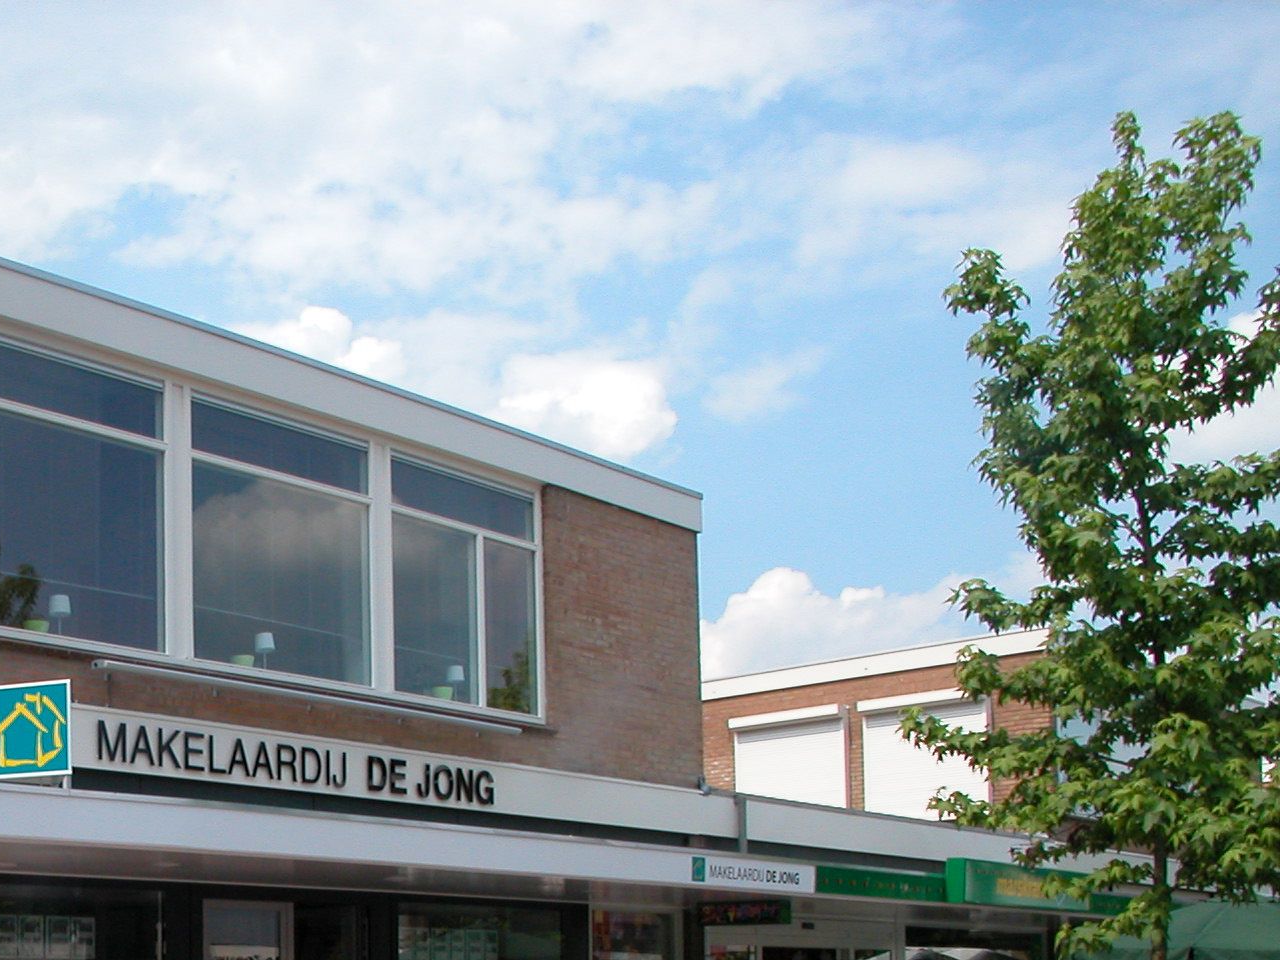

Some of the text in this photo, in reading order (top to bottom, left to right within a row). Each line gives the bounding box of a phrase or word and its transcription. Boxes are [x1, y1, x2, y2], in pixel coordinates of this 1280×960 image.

[96, 719, 496, 805] MAKELAARDIJ DE JONG
[709, 864, 800, 886] MAKELAARDIJ DE JONG
